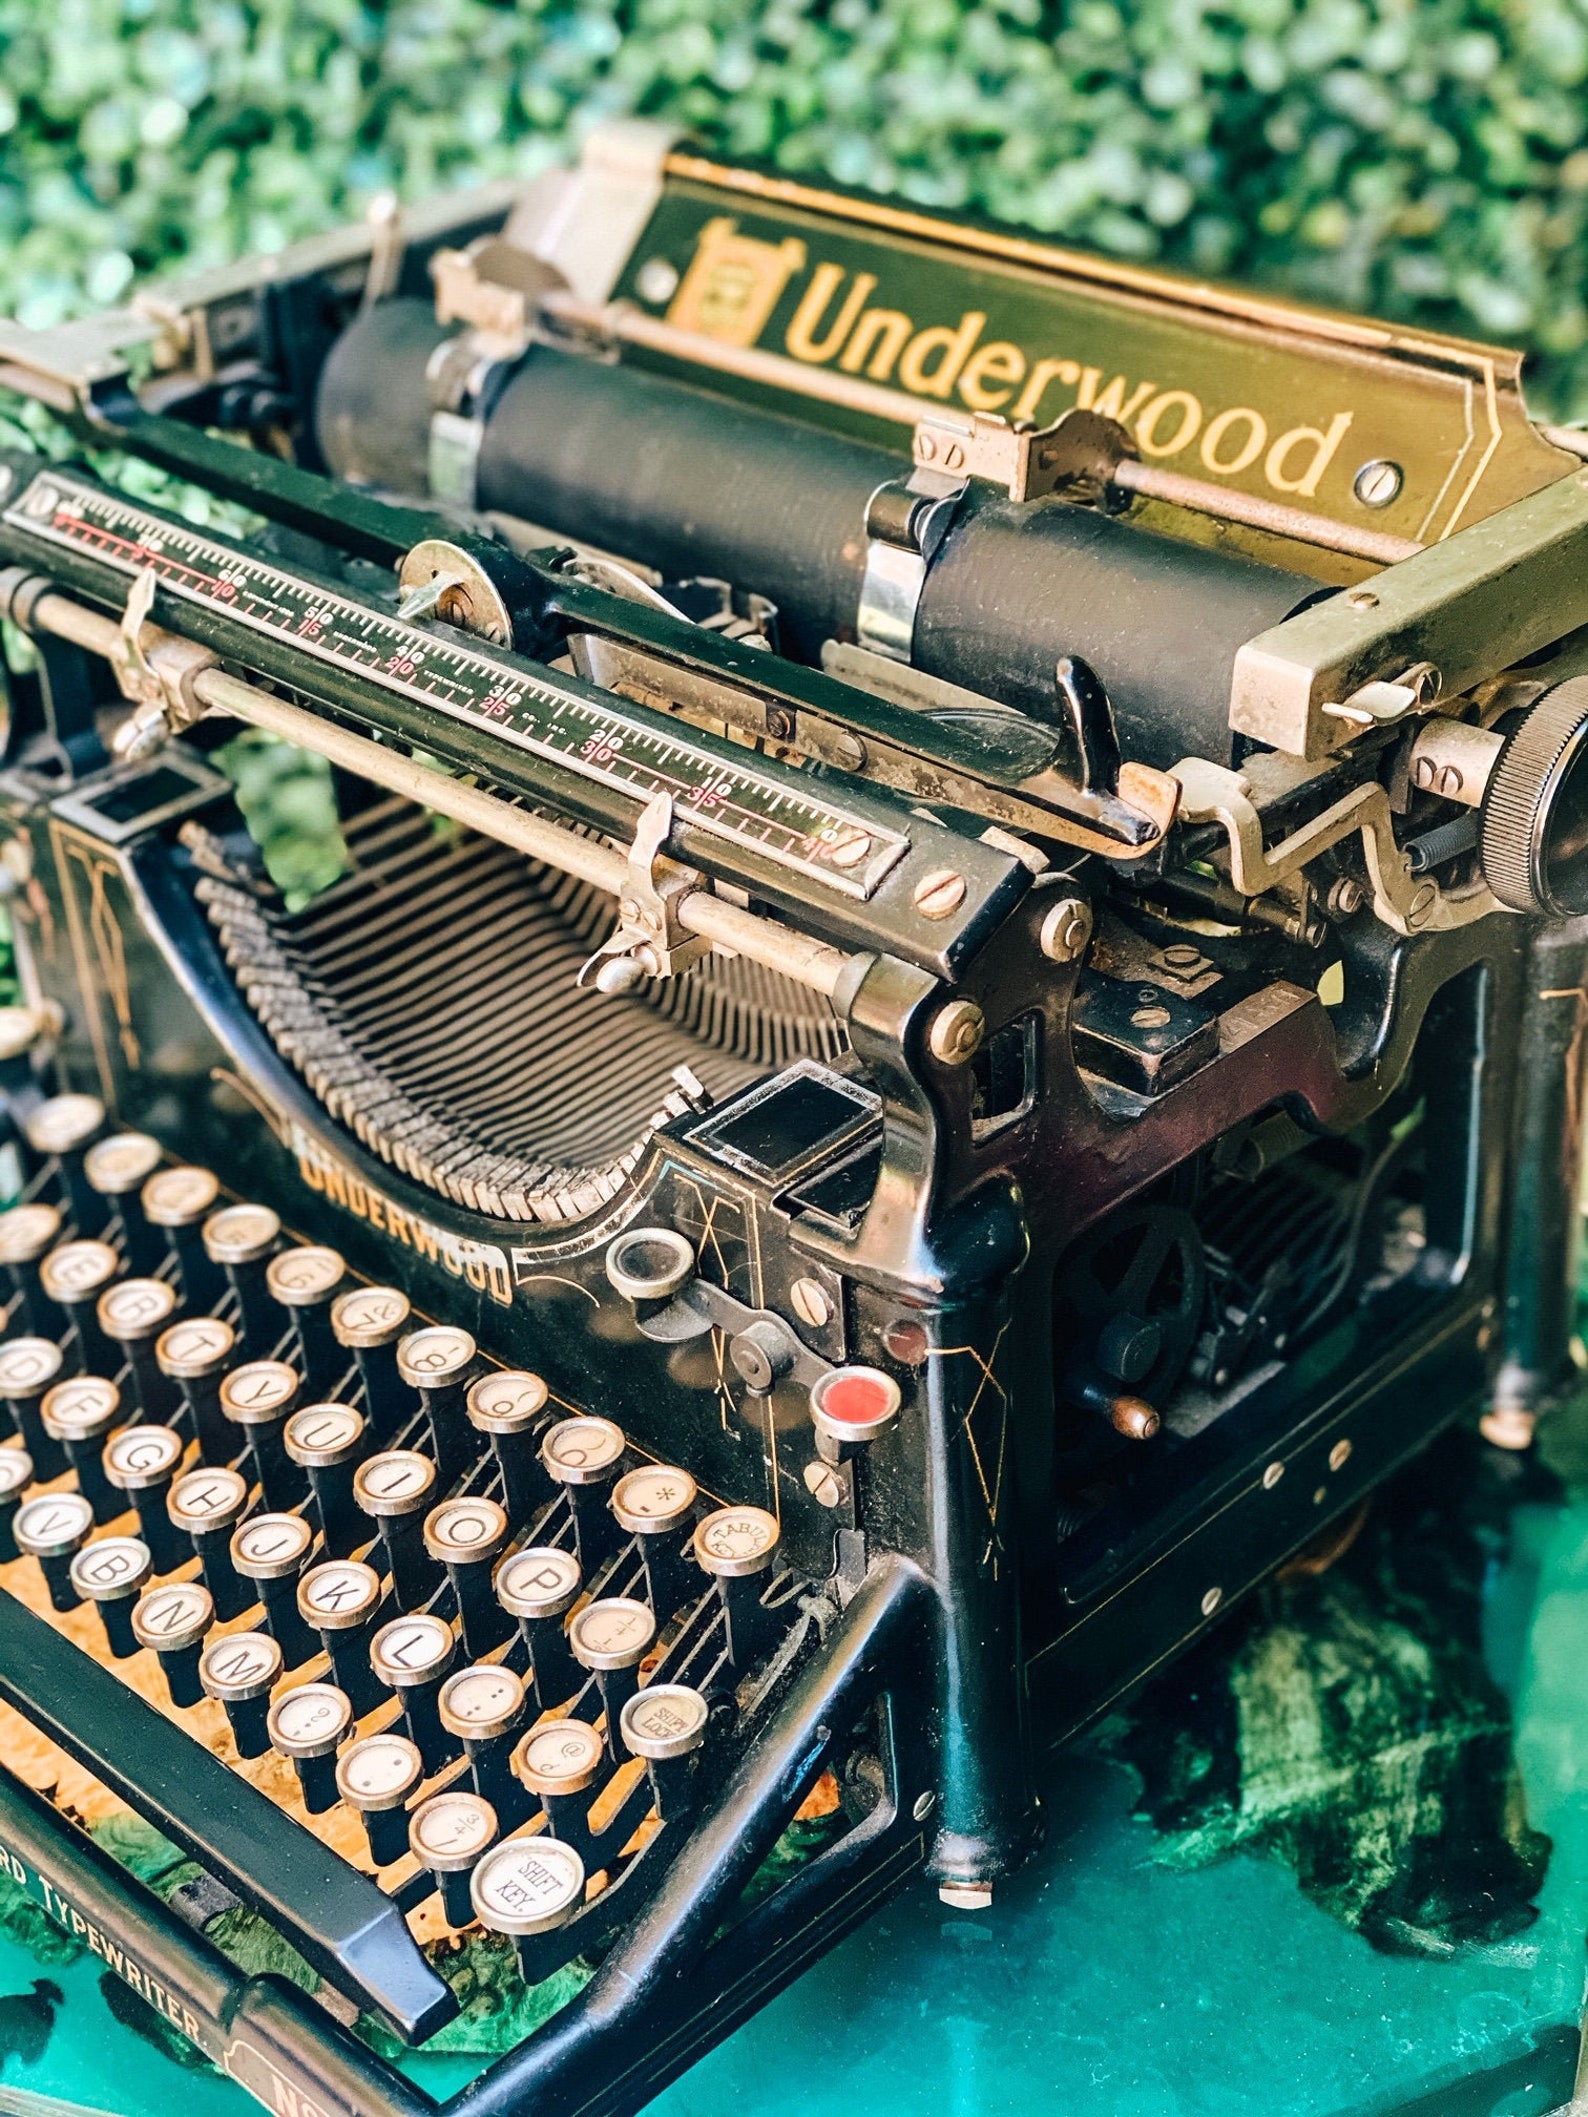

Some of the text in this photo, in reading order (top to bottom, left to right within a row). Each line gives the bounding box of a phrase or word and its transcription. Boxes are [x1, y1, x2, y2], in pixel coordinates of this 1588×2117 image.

[784, 261, 1354, 498] Underwood
[211, 580, 236, 598] 10
[298, 618, 323, 636] 15
[384, 656, 415, 675] 20
[478, 696, 511, 716] 25
[579, 740, 614, 762] 30
[686, 786, 725, 808] 35
[217, 568, 248, 588] 60
[303, 605, 335, 626] 50
[395, 645, 426, 665] 40
[488, 684, 523, 707] 30
[588, 728, 625, 750] 20
[700, 776, 733, 797] 10
[61, 1256, 102, 1285] E
[118, 1294, 159, 1322] R
[178, 1335, 217, 1359] T
[3, 1355, 44, 1382] D
[61, 1394, 104, 1415] F
[243, 1380, 284, 1405] Y
[303, 1420, 348, 1449] U
[126, 1443, 165, 1471] G
[186, 1485, 232, 1516] H
[36, 1511, 74, 1536] V
[447, 1516, 487, 1545] O
[249, 1538, 290, 1558] J
[89, 1553, 132, 1583] B
[518, 1566, 564, 1591] P
[314, 1579, 361, 1613] K
[149, 1599, 197, 1633] N
[391, 1633, 425, 1668] L
[215, 1649, 267, 1684] M
[653, 1706, 690, 1733] SHIFT
[517, 1859, 564, 1896] SHIFT
[38, 1874, 200, 2042] TYPEWRITER
